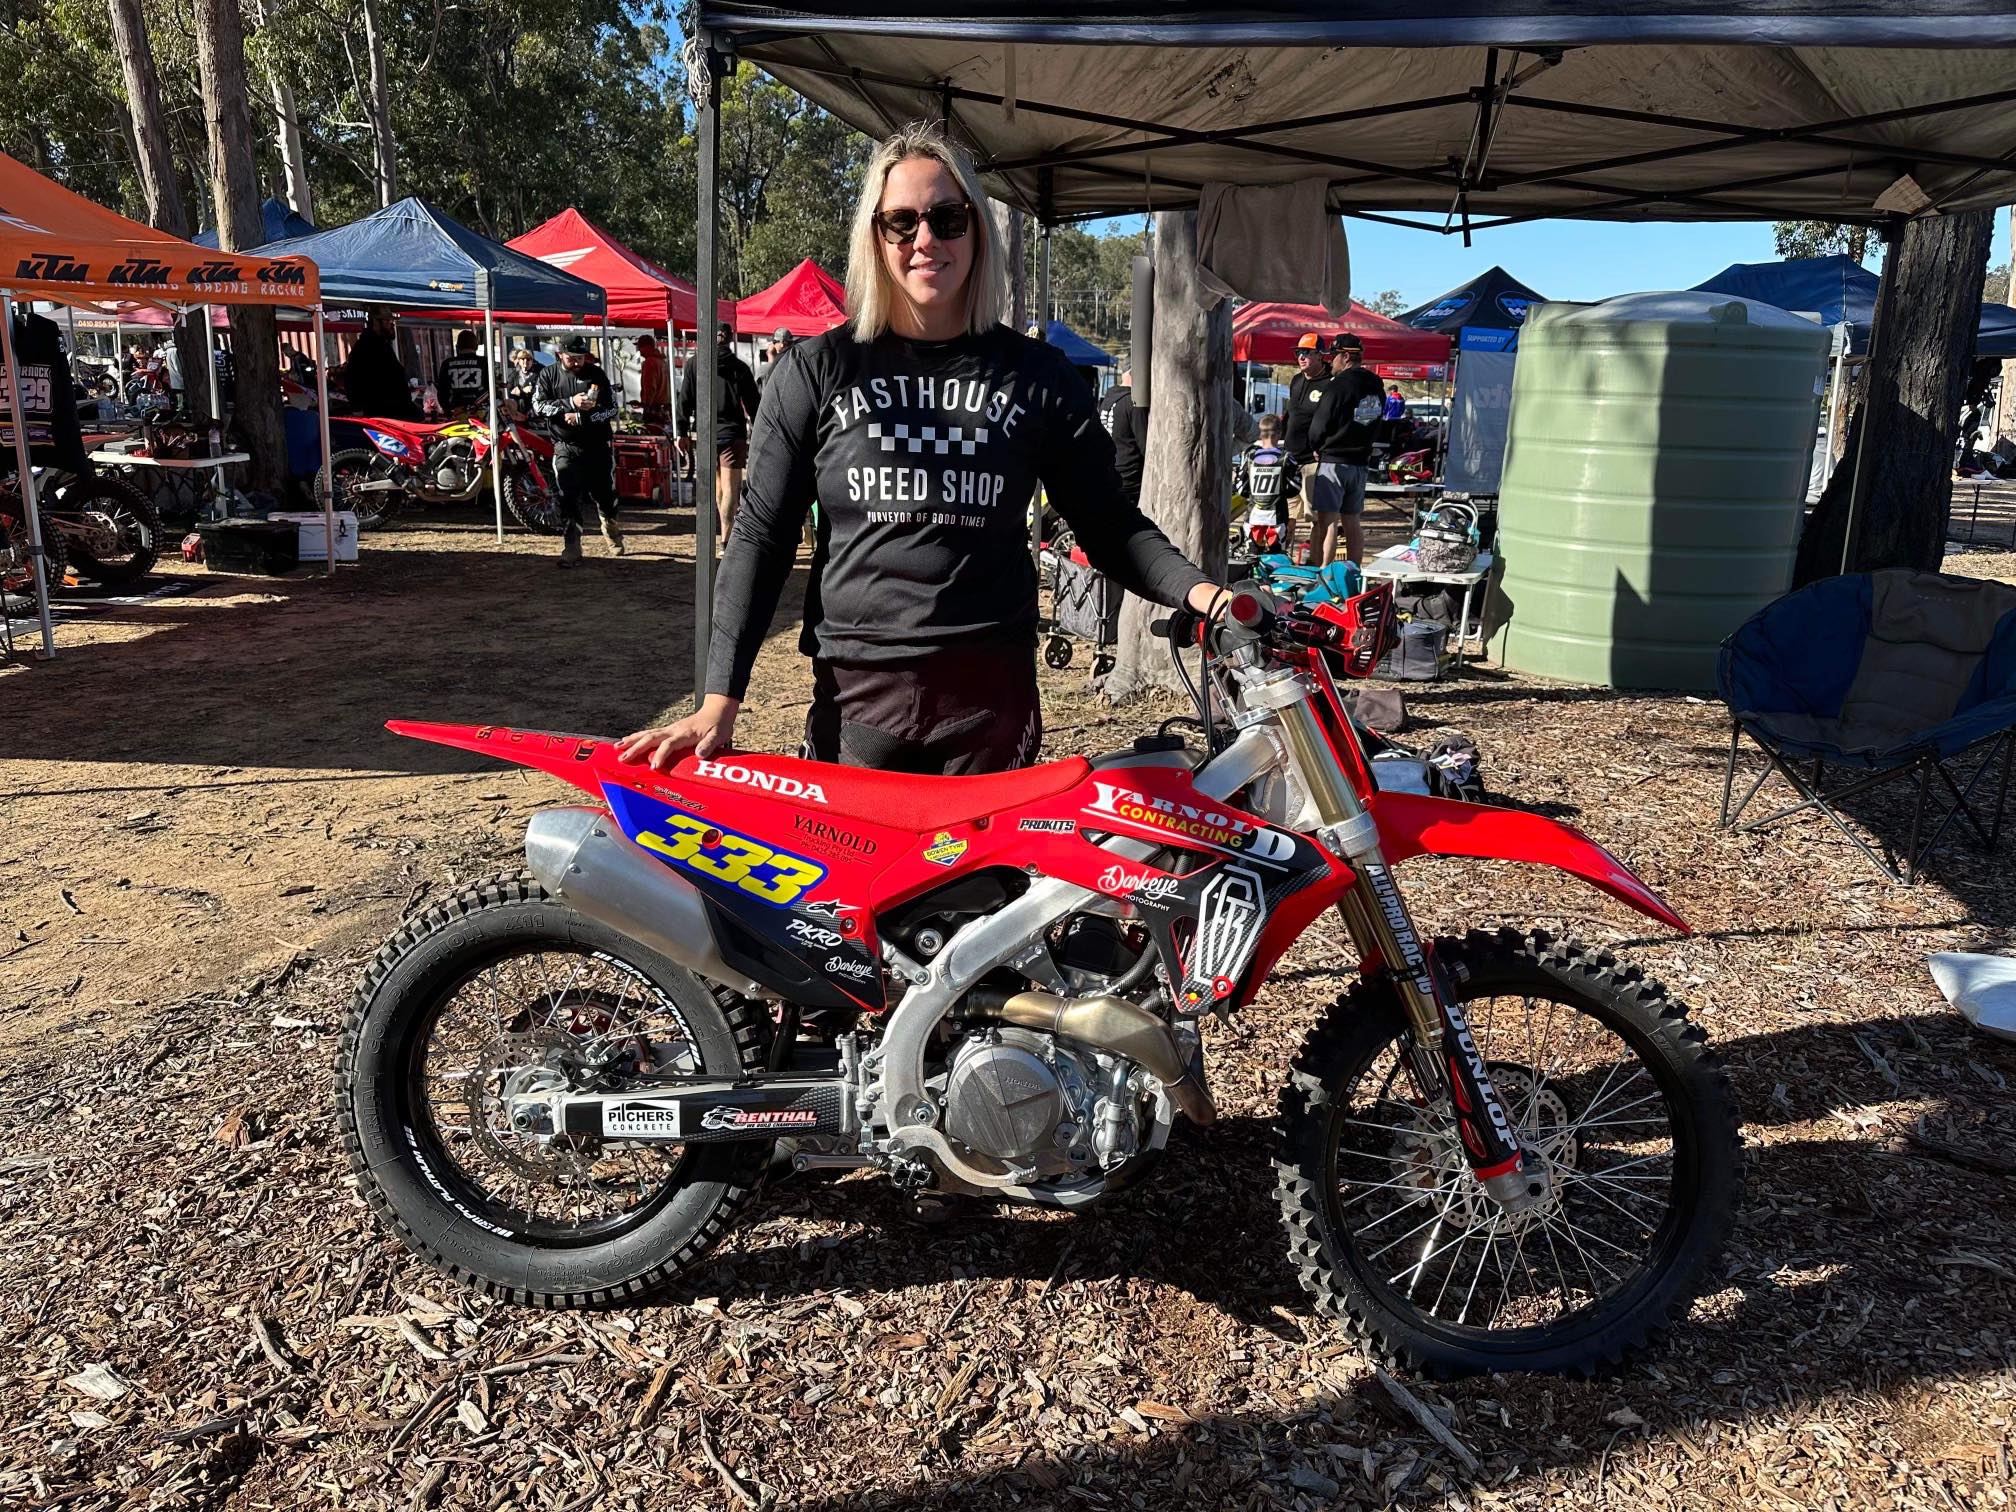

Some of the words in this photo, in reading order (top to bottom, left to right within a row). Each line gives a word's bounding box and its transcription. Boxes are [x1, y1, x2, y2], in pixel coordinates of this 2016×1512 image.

[16, 253, 90, 280] KTM
[108, 258, 172, 283] KTM
[186, 261, 245, 283] KTM
[257, 261, 305, 284] KTM
[194, 282, 248, 294] RACING
[261, 284, 305, 296] RACING
[830, 375, 1026, 438] FASTHOUSE
[847, 466, 928, 501] SPEED
[942, 469, 1004, 507] SHOP
[1253, 474, 1280, 494] 101
[916, 512, 927, 522] OF
[932, 513, 956, 524] GOOD
[960, 515, 986, 527] TIMES
[693, 760, 828, 804] HONDA
[1018, 819, 1075, 832] PROKITS
[1088, 781, 1296, 861] YARNOLD
[1119, 804, 1243, 847] CONTRACTING
[794, 814, 877, 854] YARNOLD
[636, 814, 823, 904] 333
[1098, 865, 1186, 901] Darkeye
[1121, 893, 1170, 911] PHOTOGRAPHY
[785, 918, 843, 947] PKRD
[825, 956, 875, 978] Darkeye
[1444, 1004, 1518, 1151] DUNLOP
[613, 1123, 671, 1131] CONCRETE
[734, 1111, 818, 1122] RENTHAL
